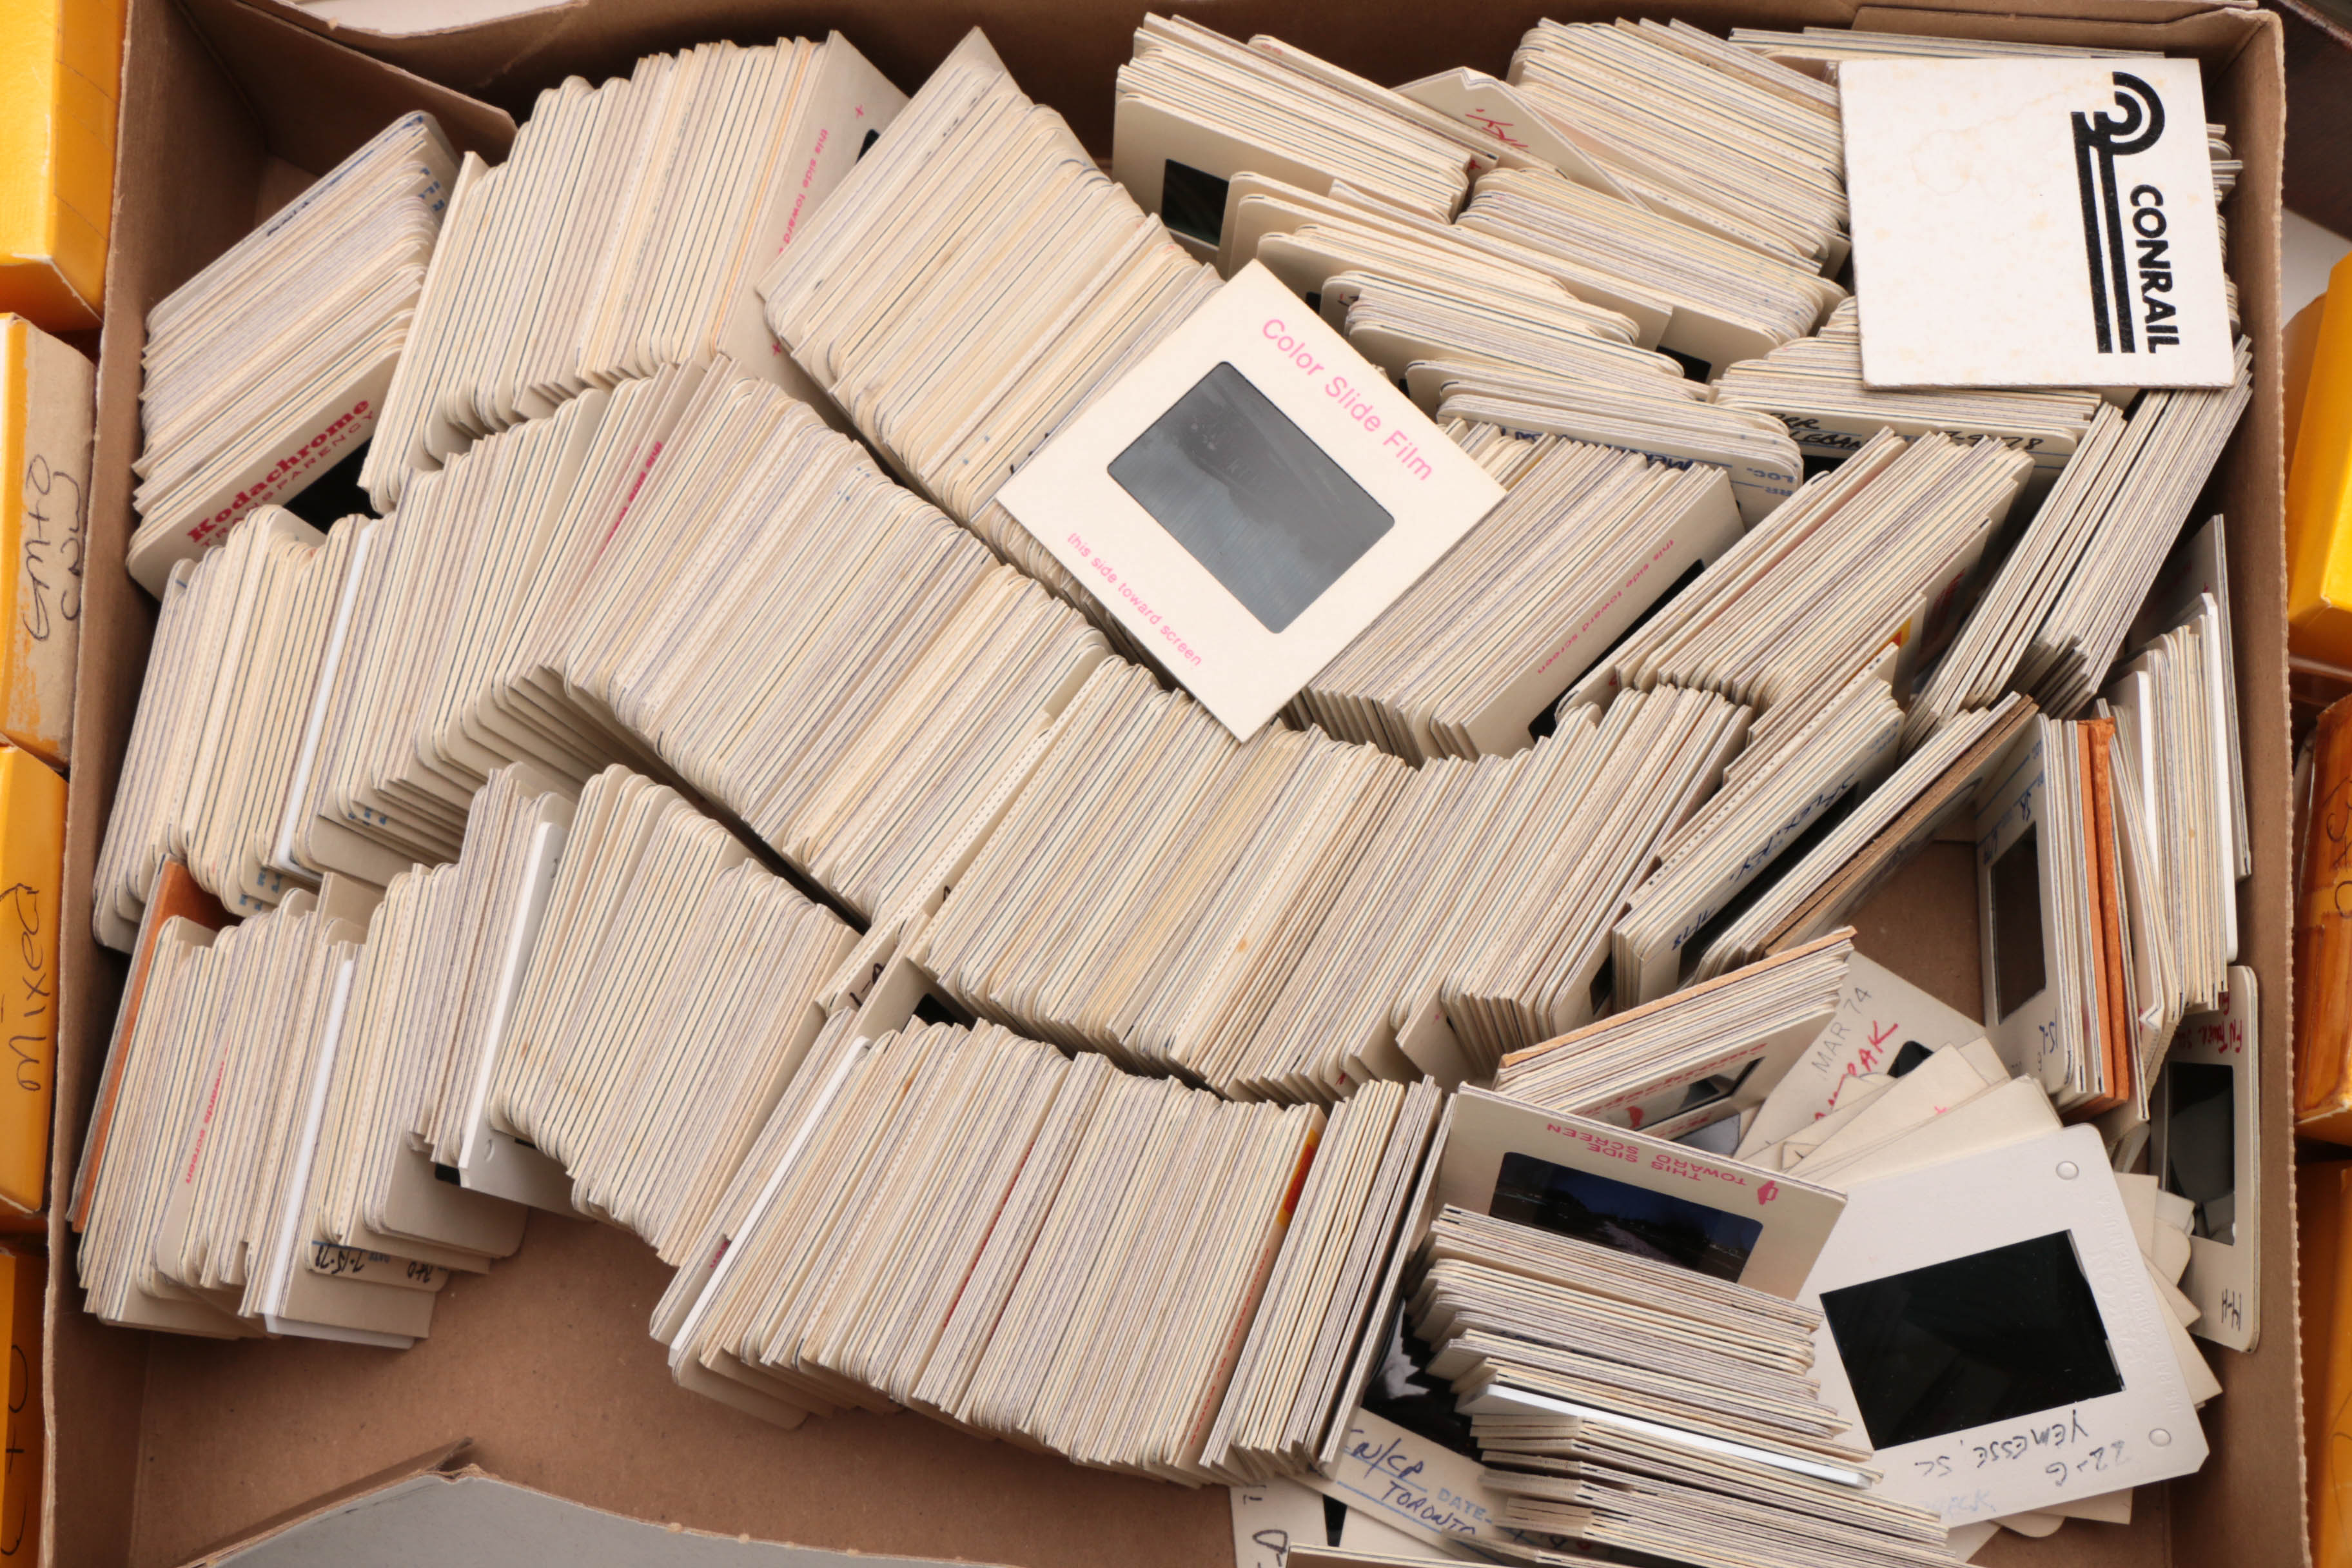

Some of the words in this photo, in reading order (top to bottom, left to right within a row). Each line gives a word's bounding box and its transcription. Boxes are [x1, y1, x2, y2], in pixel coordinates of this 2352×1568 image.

[815, 129, 828, 153] this
[803, 160, 816, 188] side
[784, 194, 805, 243] toward
[2130, 183, 2180, 355] CONRAIL
[1262, 319, 1324, 375] Color
[1326, 377, 1381, 432] Slide
[1383, 430, 1432, 480] Film
[188, 400, 369, 542] Kodachrome
[1653, 540, 1674, 560] this
[1626, 564, 1649, 587] side
[1068, 533, 1091, 557] this
[1092, 557, 1117, 583] side
[1118, 583, 1162, 624] toward
[1161, 625, 1202, 665] screen
[1582, 591, 1623, 632] toward
[1538, 634, 1578, 674] screen
[1808, 1021, 1852, 1074] MAR
[1842, 985, 1873, 1017] 74
[1546, 1123, 1640, 1156] SCREEN
[1586, 1144, 1639, 1164] SIDE
[1651, 1160, 1702, 1182] THIS
[1656, 1153, 1747, 1187] TOWARD
